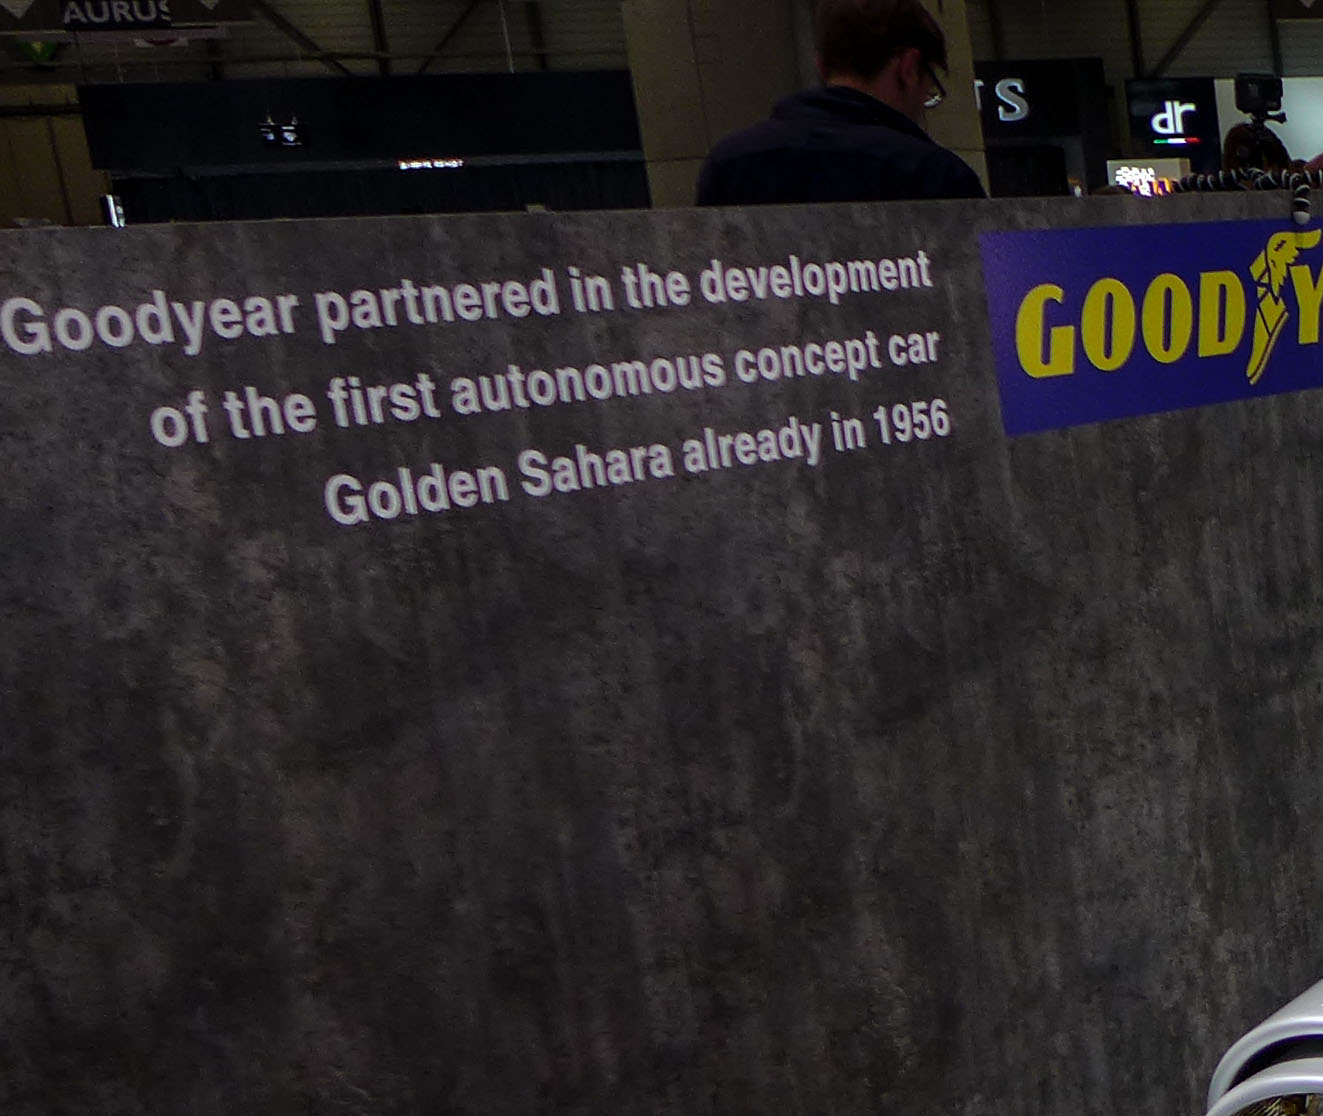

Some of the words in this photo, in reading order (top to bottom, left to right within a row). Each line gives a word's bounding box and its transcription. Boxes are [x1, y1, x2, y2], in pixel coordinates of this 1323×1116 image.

[1151, 100, 1197, 134] dr
[1, 289, 300, 356] Goodyear
[315, 267, 560, 345] partnered
[568, 266, 614, 313] in
[621, 262, 692, 309] the
[700, 249, 934, 305] development
[150, 390, 210, 449] of
[224, 386, 318, 440] the
[327, 375, 442, 429] first
[451, 351, 728, 416] autonomous
[734, 330, 883, 382] concept
[888, 330, 941, 366] car
[324, 463, 510, 526] Golden
[517, 443, 675, 499] Sahara
[682, 416, 822, 467] already
[830, 411, 867, 453] in
[873, 398, 952, 446] 1956
